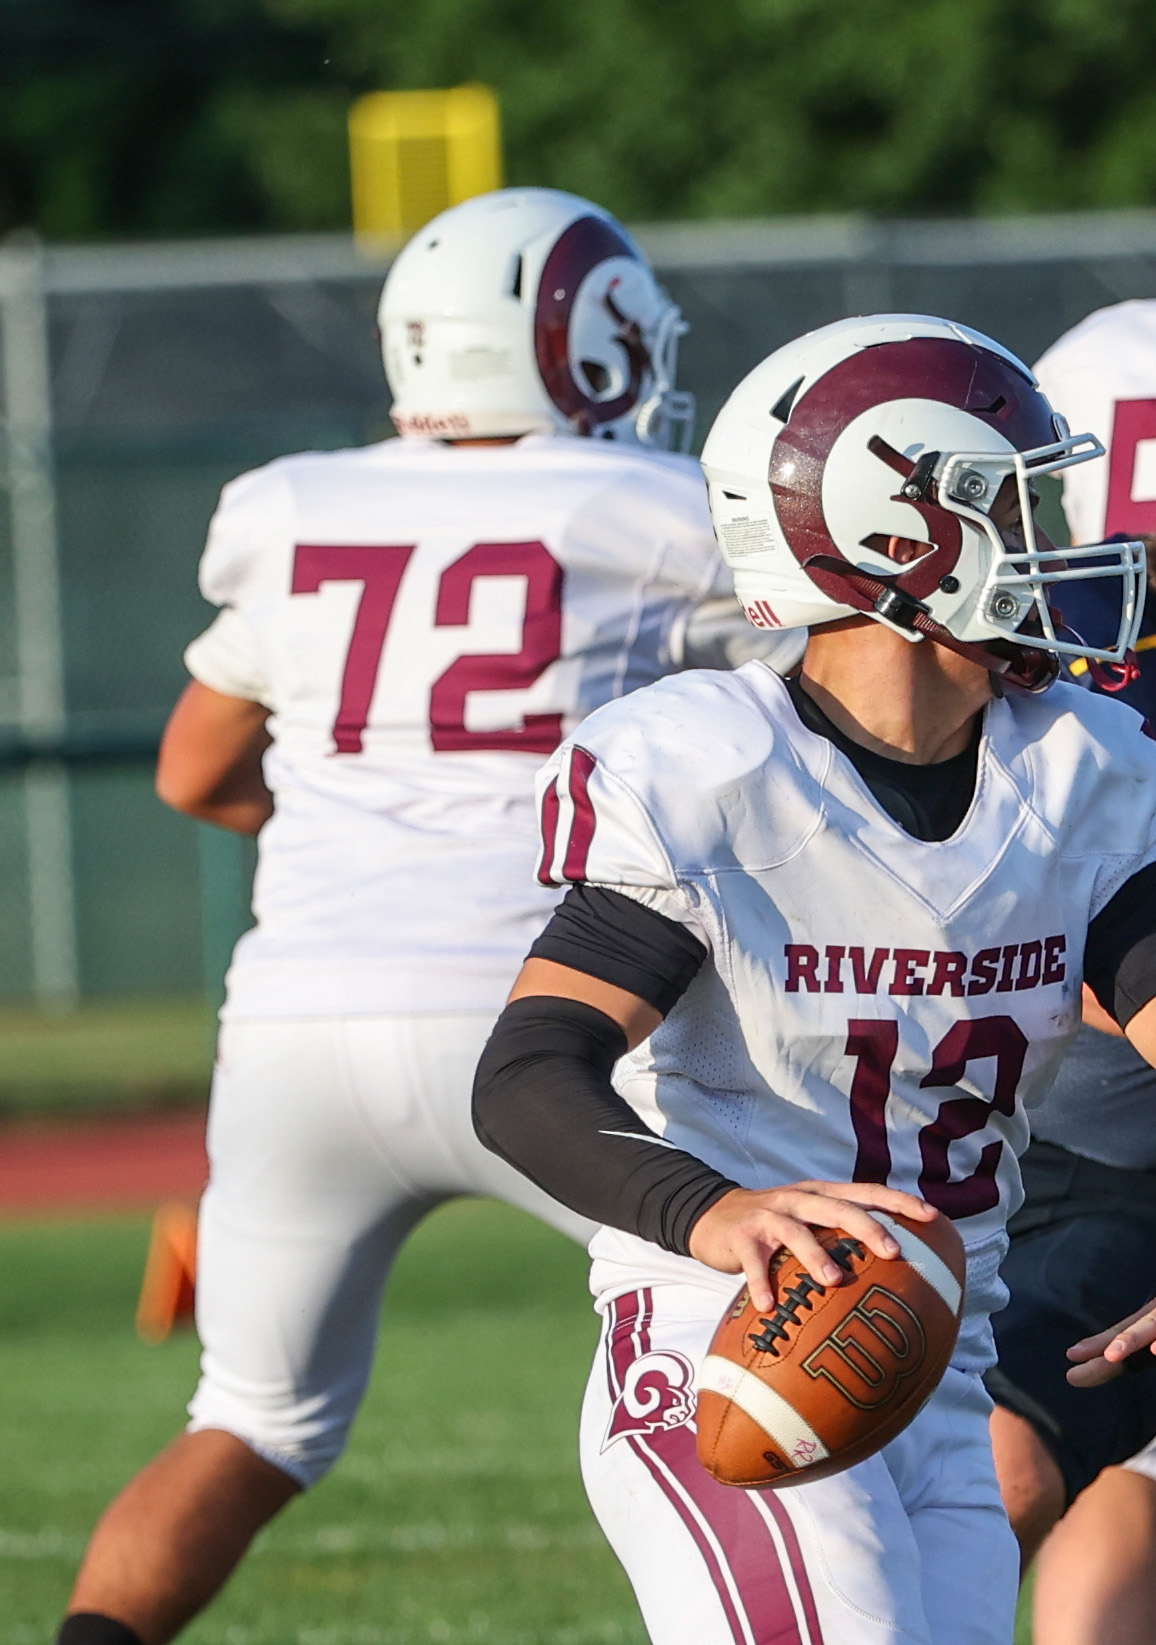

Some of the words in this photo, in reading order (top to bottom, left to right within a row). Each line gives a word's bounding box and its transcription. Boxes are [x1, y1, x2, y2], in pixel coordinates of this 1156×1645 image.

[290, 540, 565, 756] 72
[784, 934, 1067, 998] RIVERSIDE
[844, 1015, 1030, 1220] 12
